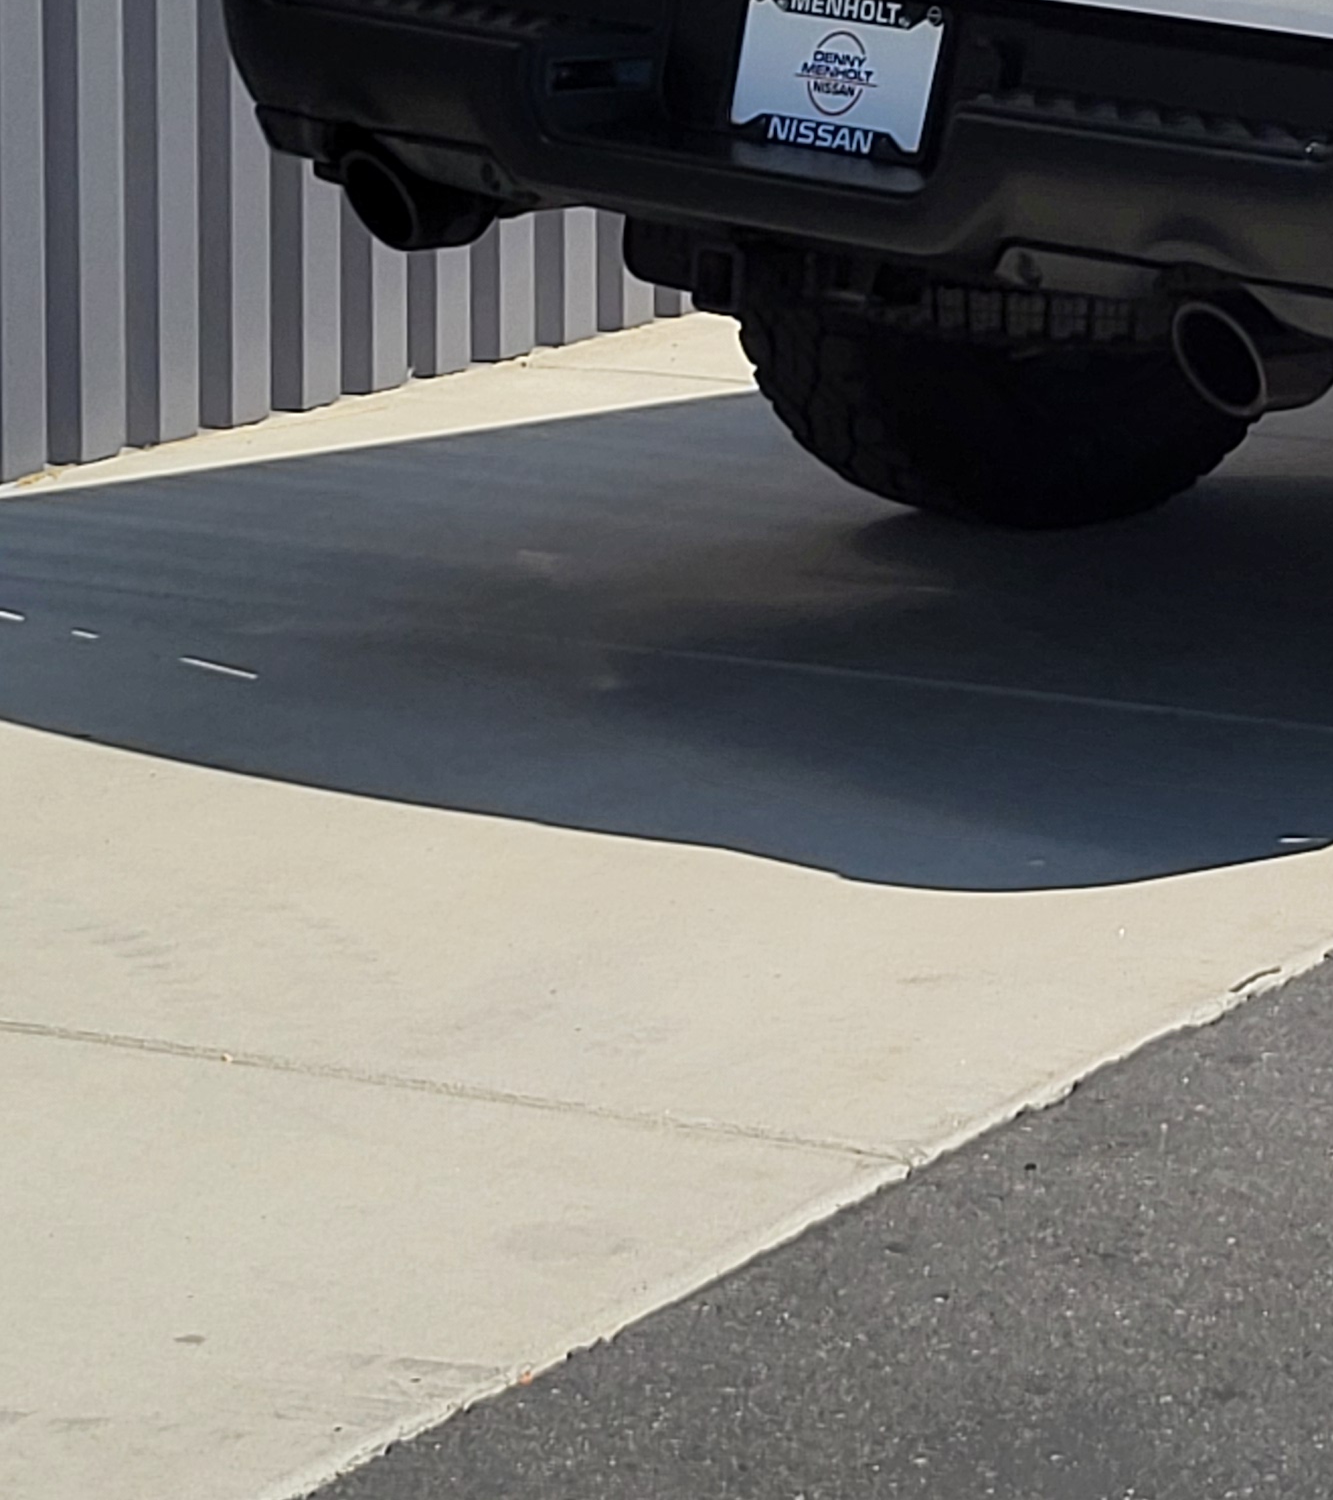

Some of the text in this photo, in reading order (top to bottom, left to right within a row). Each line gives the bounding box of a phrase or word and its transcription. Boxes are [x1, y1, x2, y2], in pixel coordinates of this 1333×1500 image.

[813, 50, 867, 67] DENNY
[801, 62, 874, 83] MENHOLT
[812, 81, 856, 98] NISSAN
[766, 117, 874, 154] NISSAN
